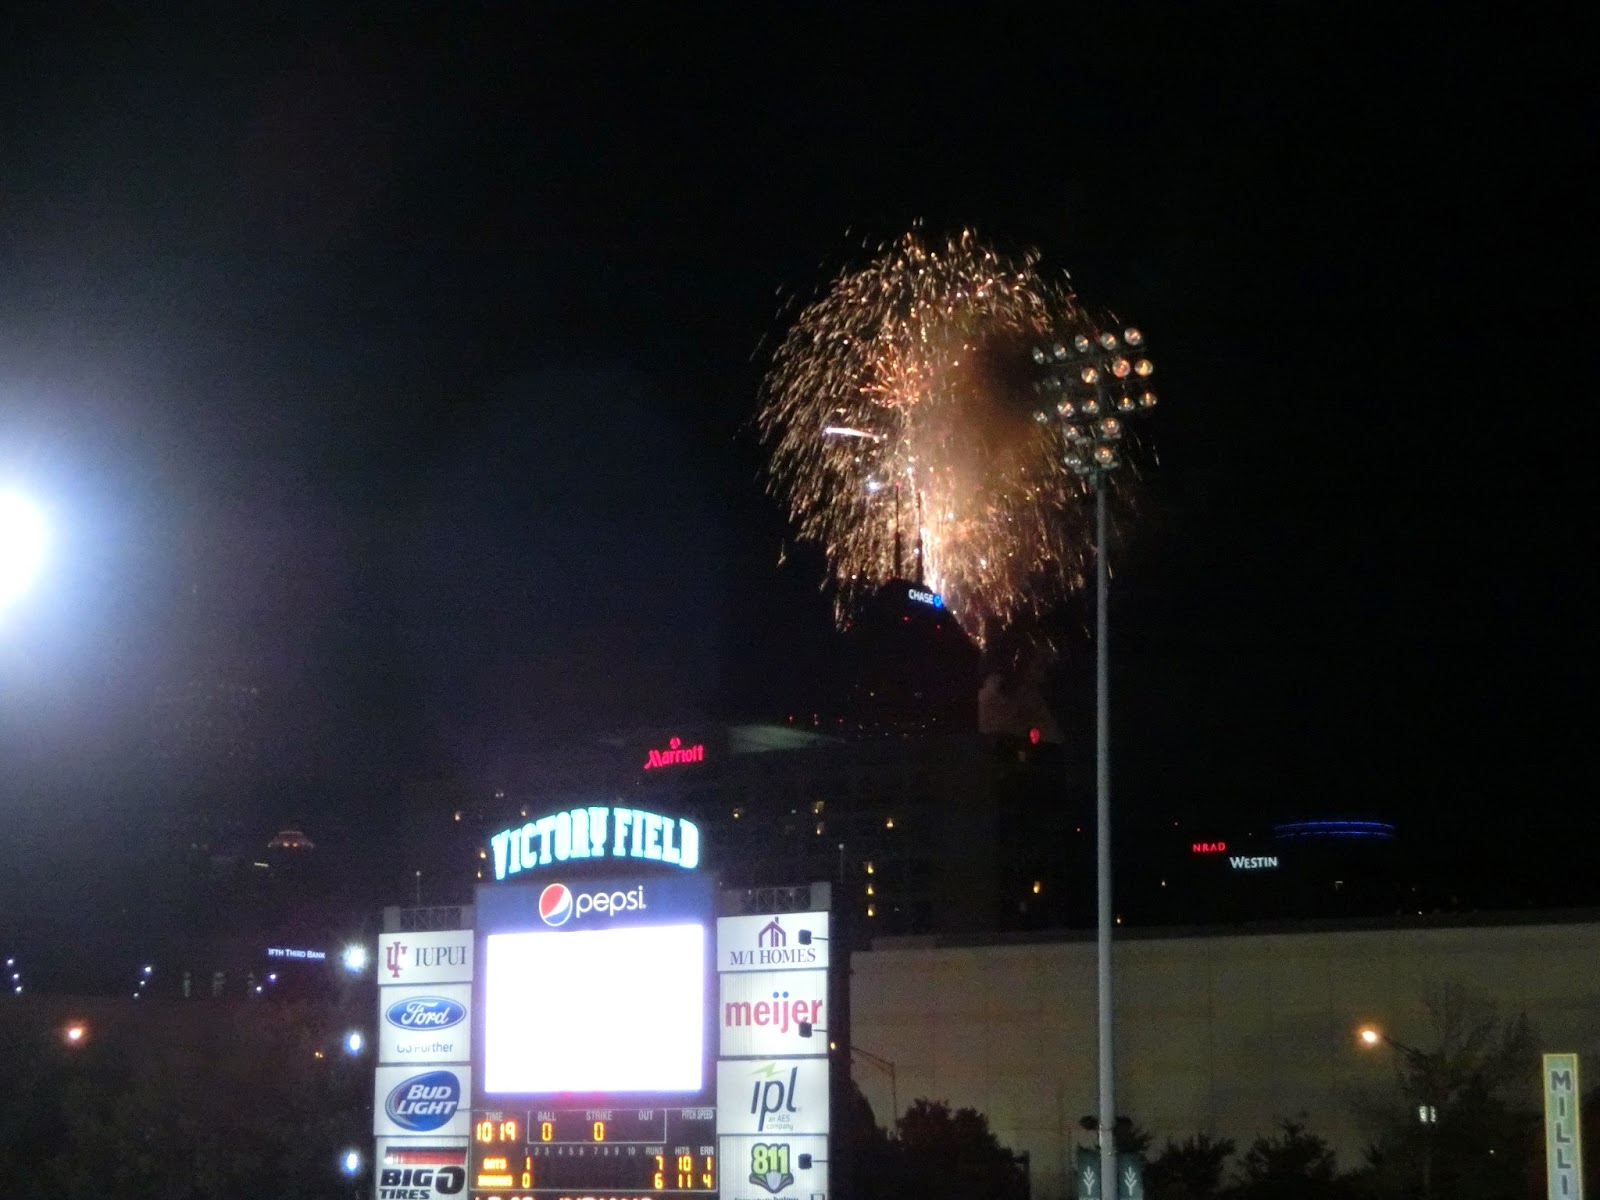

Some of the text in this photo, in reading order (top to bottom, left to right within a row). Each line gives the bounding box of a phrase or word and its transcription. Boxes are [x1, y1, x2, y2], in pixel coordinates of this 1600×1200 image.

[908, 589, 934, 604] CHASE
[491, 807, 699, 880] VICTORY FIELD
[1193, 842, 1226, 852] NRAD
[415, 946, 467, 967] IUPUI
[759, 948, 816, 964] HOMES
[401, 1001, 450, 1024] Ford
[725, 991, 823, 1033] meijer
[485, 1112, 503, 1121] TIME
[538, 1111, 556, 1121] BALL
[586, 1111, 612, 1120] STRIKE
[638, 1110, 653, 1120] OUT
[682, 1109, 713, 1119] PITCH SPEED
[542, 1122, 552, 1141] 0
[594, 1122, 604, 1141] 0
[646, 1147, 663, 1155] RUNS
[675, 1147, 690, 1155] HITS
[701, 1147, 714, 1155] ERR
[655, 1156, 664, 1170] 7
[679, 1156, 692, 1171] 10
[752, 1143, 790, 1175] 811
[380, 1169, 434, 1186] BIG
[522, 1173, 531, 1188] 0
[655, 1173, 664, 1189] 6
[679, 1174, 692, 1188] 11
[703, 1174, 712, 1188] 4
[379, 1188, 431, 1199] TIRES
